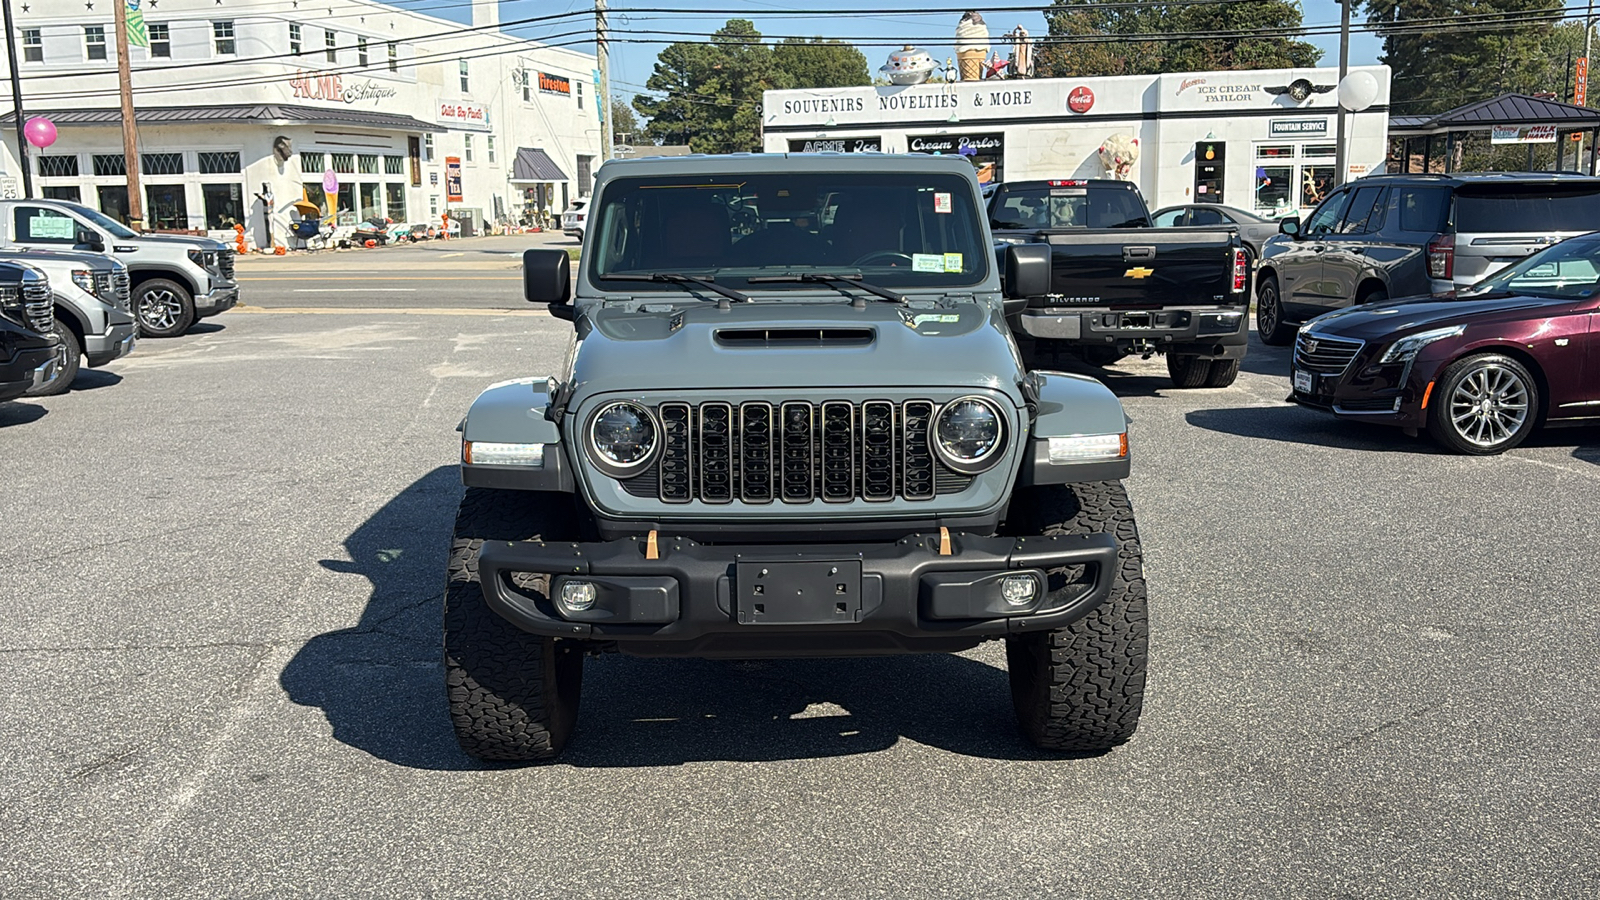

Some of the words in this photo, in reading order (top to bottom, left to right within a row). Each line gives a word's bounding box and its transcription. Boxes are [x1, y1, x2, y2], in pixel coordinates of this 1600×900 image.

[290, 68, 344, 102] ACME
[1198, 86, 1216, 94] ICE
[1218, 84, 1261, 94] CREAM
[784, 97, 864, 114] SOUVENIRS
[879, 94, 958, 110] NOVELTIES
[973, 93, 984, 107] &
[989, 91, 1032, 106] MORE
[1205, 94, 1251, 103] PARLOR
[441, 104, 456, 117] Dutch
[457, 106, 467, 121] Boy
[467, 107, 483, 120] Paints
[1273, 123, 1301, 132] FOUNTAIN
[1301, 121, 1325, 131] SERVICE
[1530, 125, 1557, 133] MILK
[803, 141, 845, 153] ACME
[853, 140, 879, 153] Ice
[911, 138, 952, 151] Cream
[958, 136, 1001, 149] Parlor
[4, 189, 16, 198] 25
